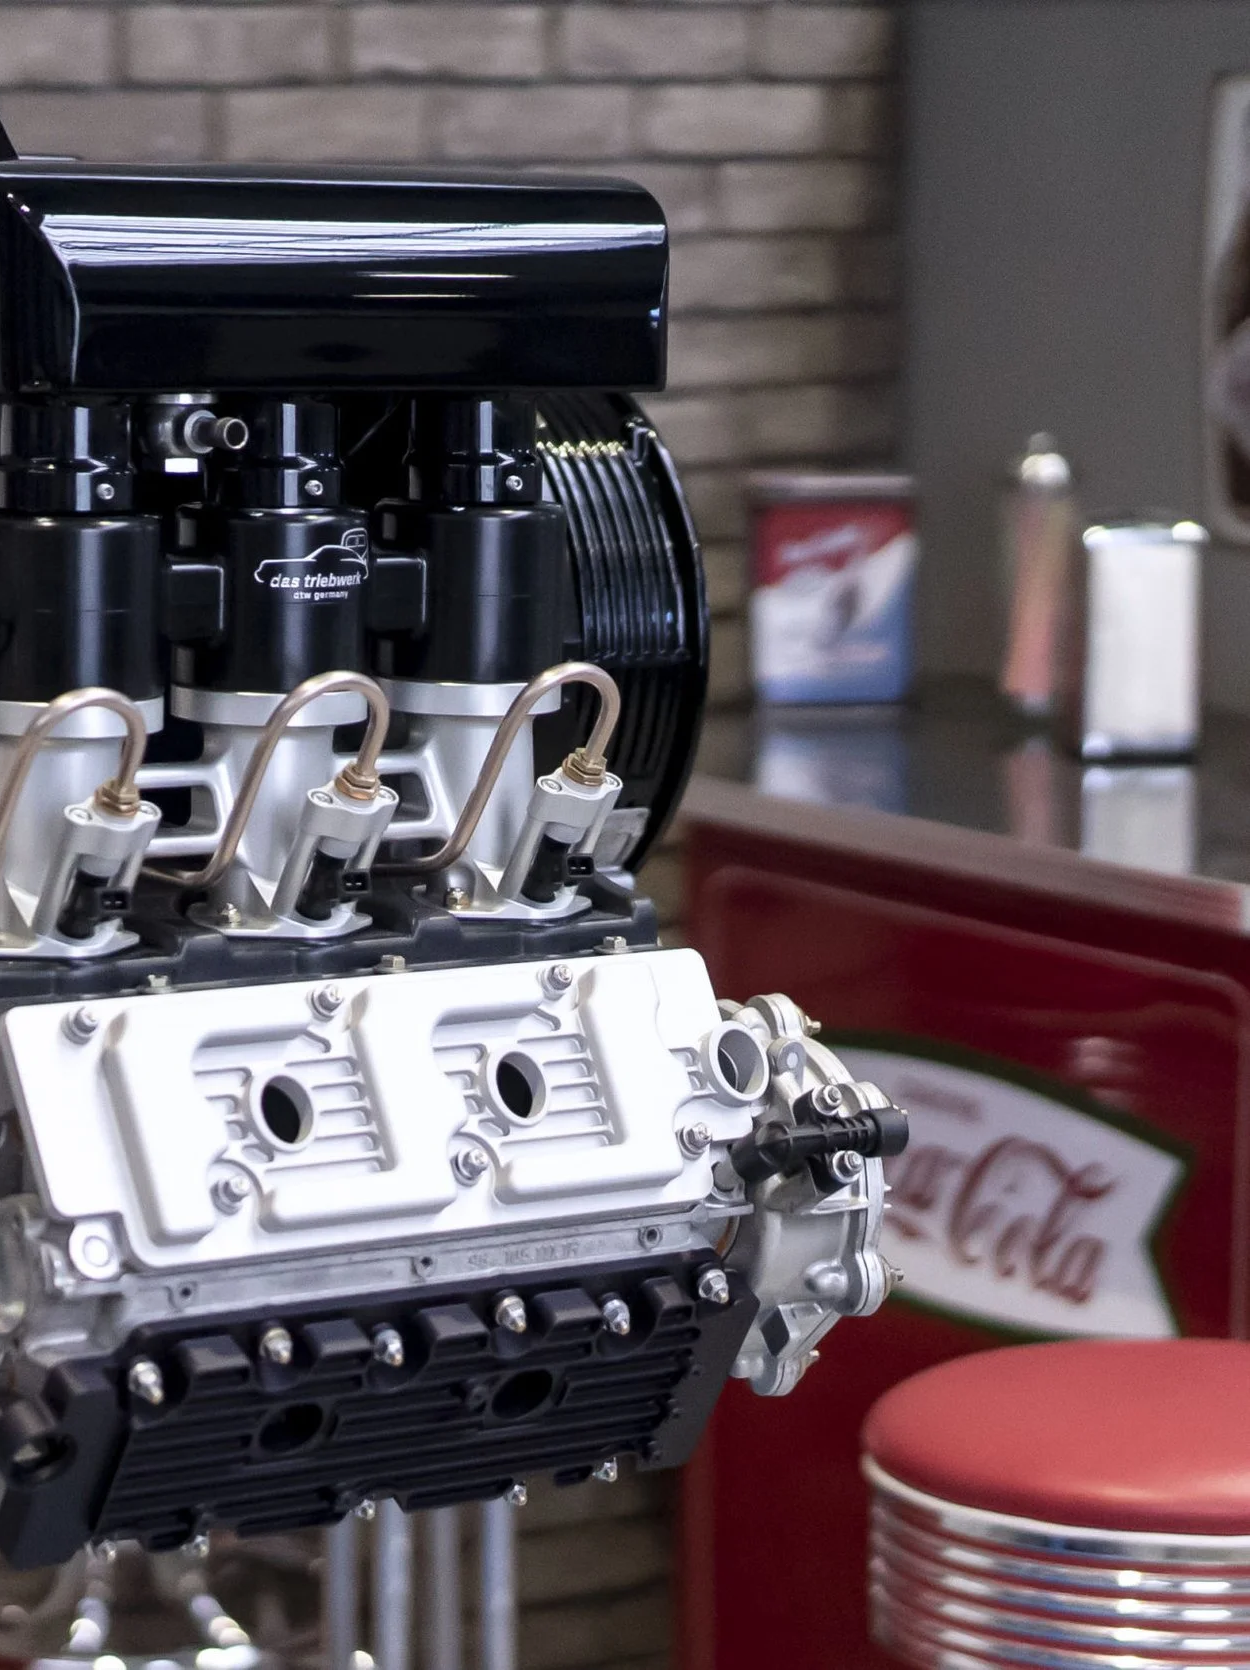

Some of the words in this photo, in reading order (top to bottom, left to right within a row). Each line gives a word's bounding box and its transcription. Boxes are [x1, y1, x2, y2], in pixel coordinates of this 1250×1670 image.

[270, 574, 300, 588] das
[304, 572, 361, 588] triebwerk
[293, 590, 311, 600] dtw
[314, 590, 349, 601] germany
